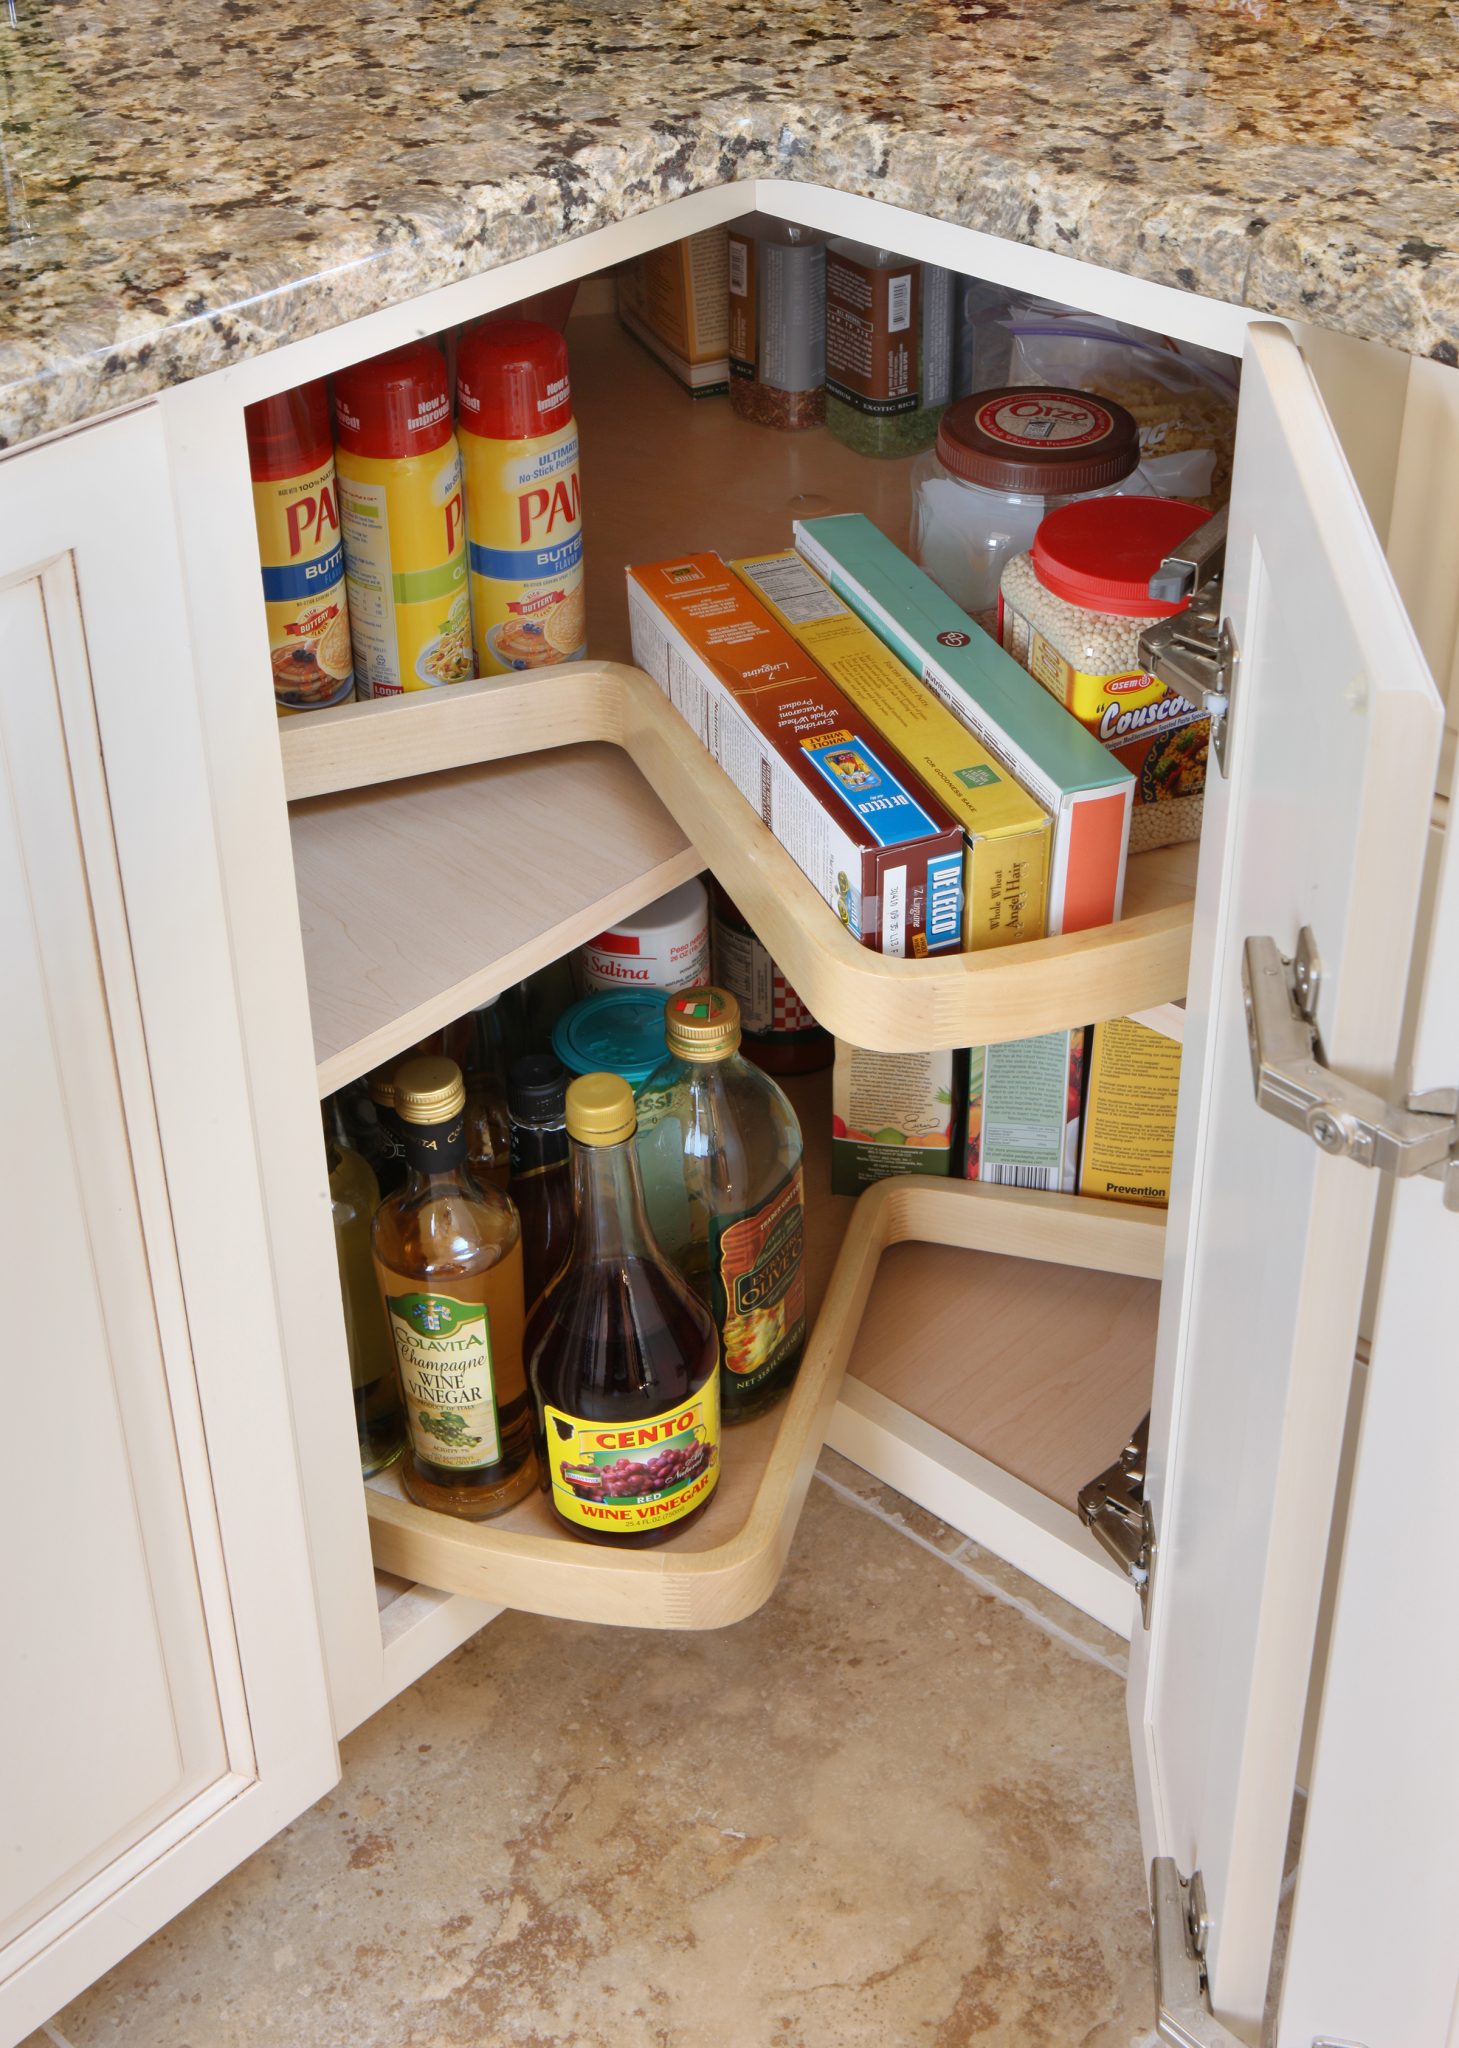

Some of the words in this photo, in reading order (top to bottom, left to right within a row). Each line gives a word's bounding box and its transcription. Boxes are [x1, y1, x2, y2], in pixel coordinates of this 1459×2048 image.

[418, 397, 439, 415] New
[863, 403, 896, 412] EXOTIC
[1009, 401, 1089, 422] Orzo
[299, 480, 320, 492] 100%
[522, 593, 554, 614] BUTTERY
[300, 610, 329, 634] BUTTERY
[742, 661, 790, 679] Linguine
[925, 669, 951, 699] Nutrition
[1111, 679, 1139, 691] OSEM
[778, 699, 814, 711] Product
[778, 703, 824, 717] Macaroni
[808, 709, 840, 721] Whole
[778, 716, 809, 728] Wheat
[794, 718, 834, 733] Enriched
[808, 731, 844, 743] WHEAT
[810, 737, 847, 748] WHOLE
[924, 756, 936, 769] FOR
[933, 768, 963, 797] GOODNESS
[960, 797, 977, 812] SAKE
[855, 797, 891, 813] CECCO
[888, 794, 909, 806] DE
[933, 866, 960, 890] DE
[991, 869, 1003, 899] Wheat
[1006, 862, 1022, 892] Hair
[909, 897, 924, 928] Linguine
[932, 887, 960, 935] CECCO
[990, 901, 1002, 930] Whole
[1004, 893, 1022, 929] Angel
[591, 955, 651, 980] Salina
[1106, 1182, 1166, 1198] Prevention
[742, 1256, 790, 1307] OLIVE
[394, 1326, 484, 1353] COLAVITA
[396, 1341, 487, 1376] Champagne
[418, 1371, 466, 1390] WINE
[736, 1376, 757, 1390] NET
[408, 1380, 483, 1404] VINEGAR
[417, 1399, 444, 1411] PRODUCT
[456, 1403, 475, 1411] ITALY
[596, 1411, 694, 1450] CENTO
[580, 1503, 633, 1521] WINE
[636, 1474, 709, 1517] VINEGAR
[636, 1492, 662, 1504] RED
